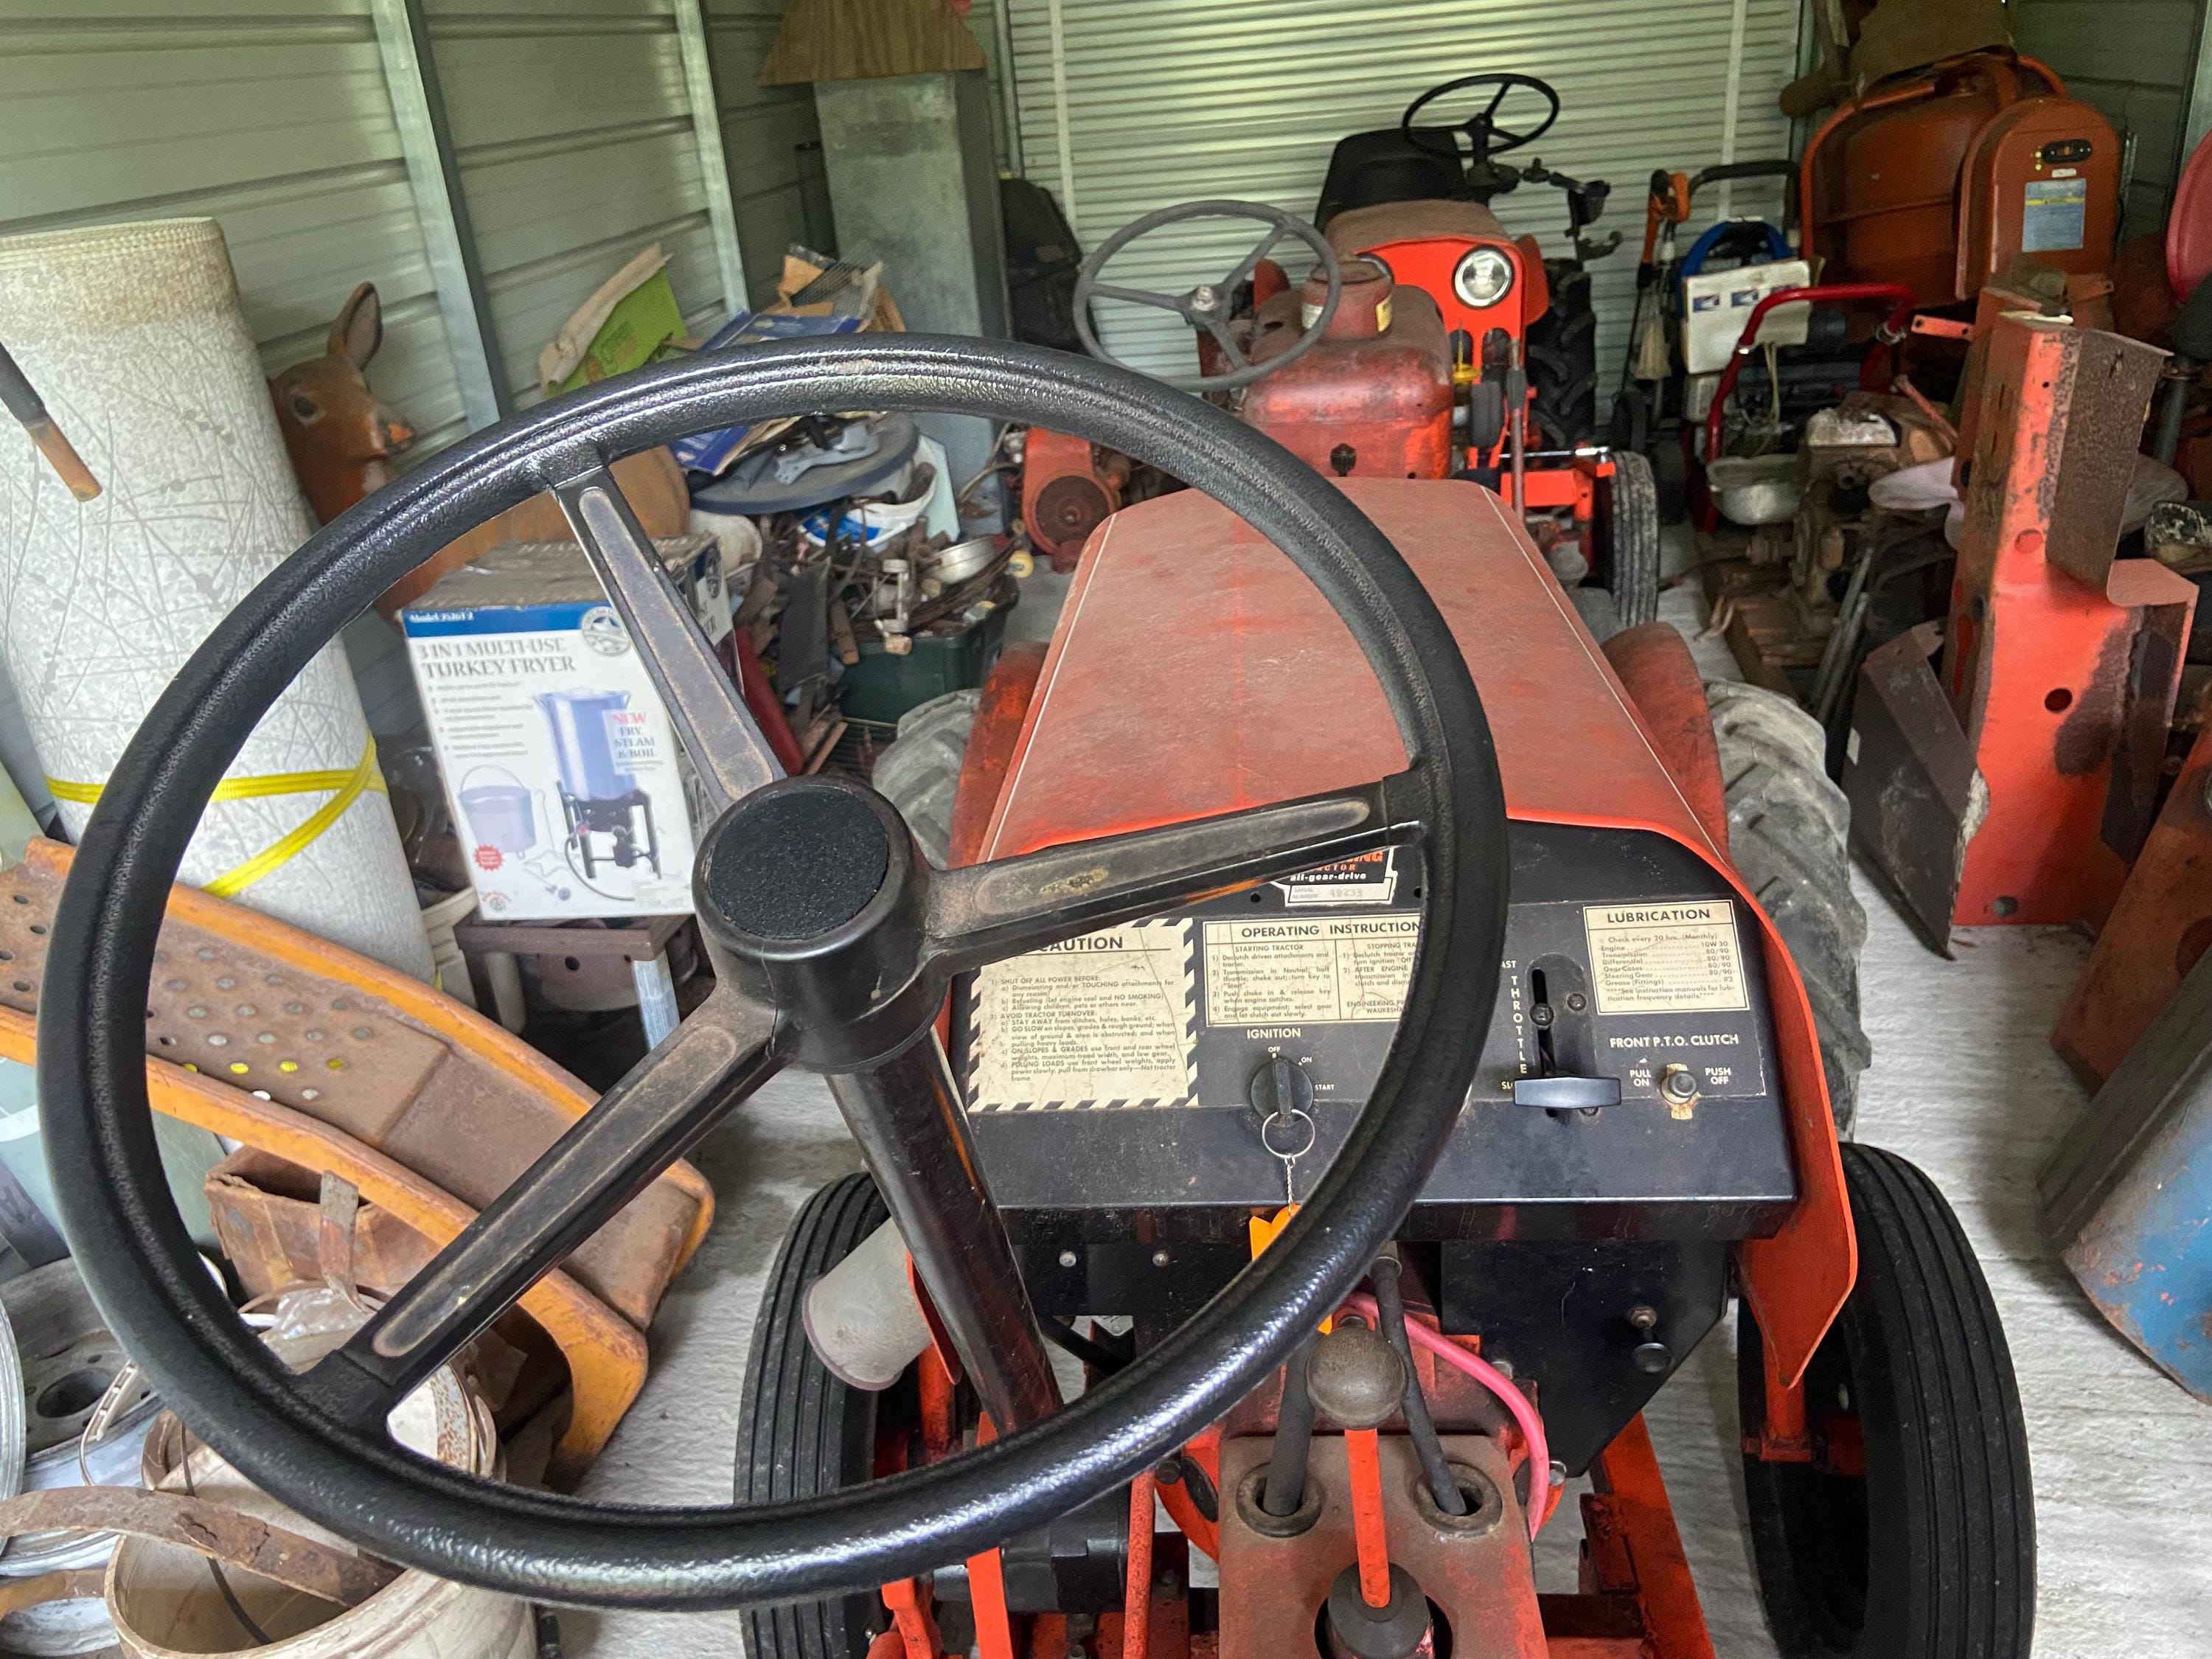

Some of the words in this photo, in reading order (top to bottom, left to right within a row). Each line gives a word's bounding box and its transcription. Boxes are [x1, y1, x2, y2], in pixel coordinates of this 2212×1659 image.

[430, 642, 451, 658] IN
[464, 637, 568, 656] MULTI-USE
[421, 658, 507, 678] TURKEY
[509, 655, 577, 674] FRYER
[611, 712, 646, 724] NEW
[613, 737, 655, 747] STEAM
[1290, 872, 1366, 882] all-gear-drive
[1607, 909, 1710, 922] LUBRICATION
[1242, 925, 1320, 937] OPERATING
[1329, 922, 1420, 934] INSTRUCTION
[1683, 933, 1717, 941] (Monthly)
[1038, 936, 1122, 952] AUTION
[1369, 959, 1395, 967] ignition
[1632, 978, 1663, 987] (Fittings)
[1319, 987, 1331, 995] key
[1637, 994, 1672, 1002] frequency
[1511, 975, 1527, 1074] THROTTLE
[1247, 1028, 1301, 1039] IGNITION
[1610, 1037, 1650, 1048] FRONT
[1652, 1036, 1688, 1047] P.T.O.
[1690, 1034, 1739, 1046] CLUTCH
[1630, 1069, 1651, 1078] PULL
[1705, 1067, 1731, 1077] PUSH
[1633, 1078, 1649, 1087] ON
[1710, 1077, 1729, 1085] OFF
